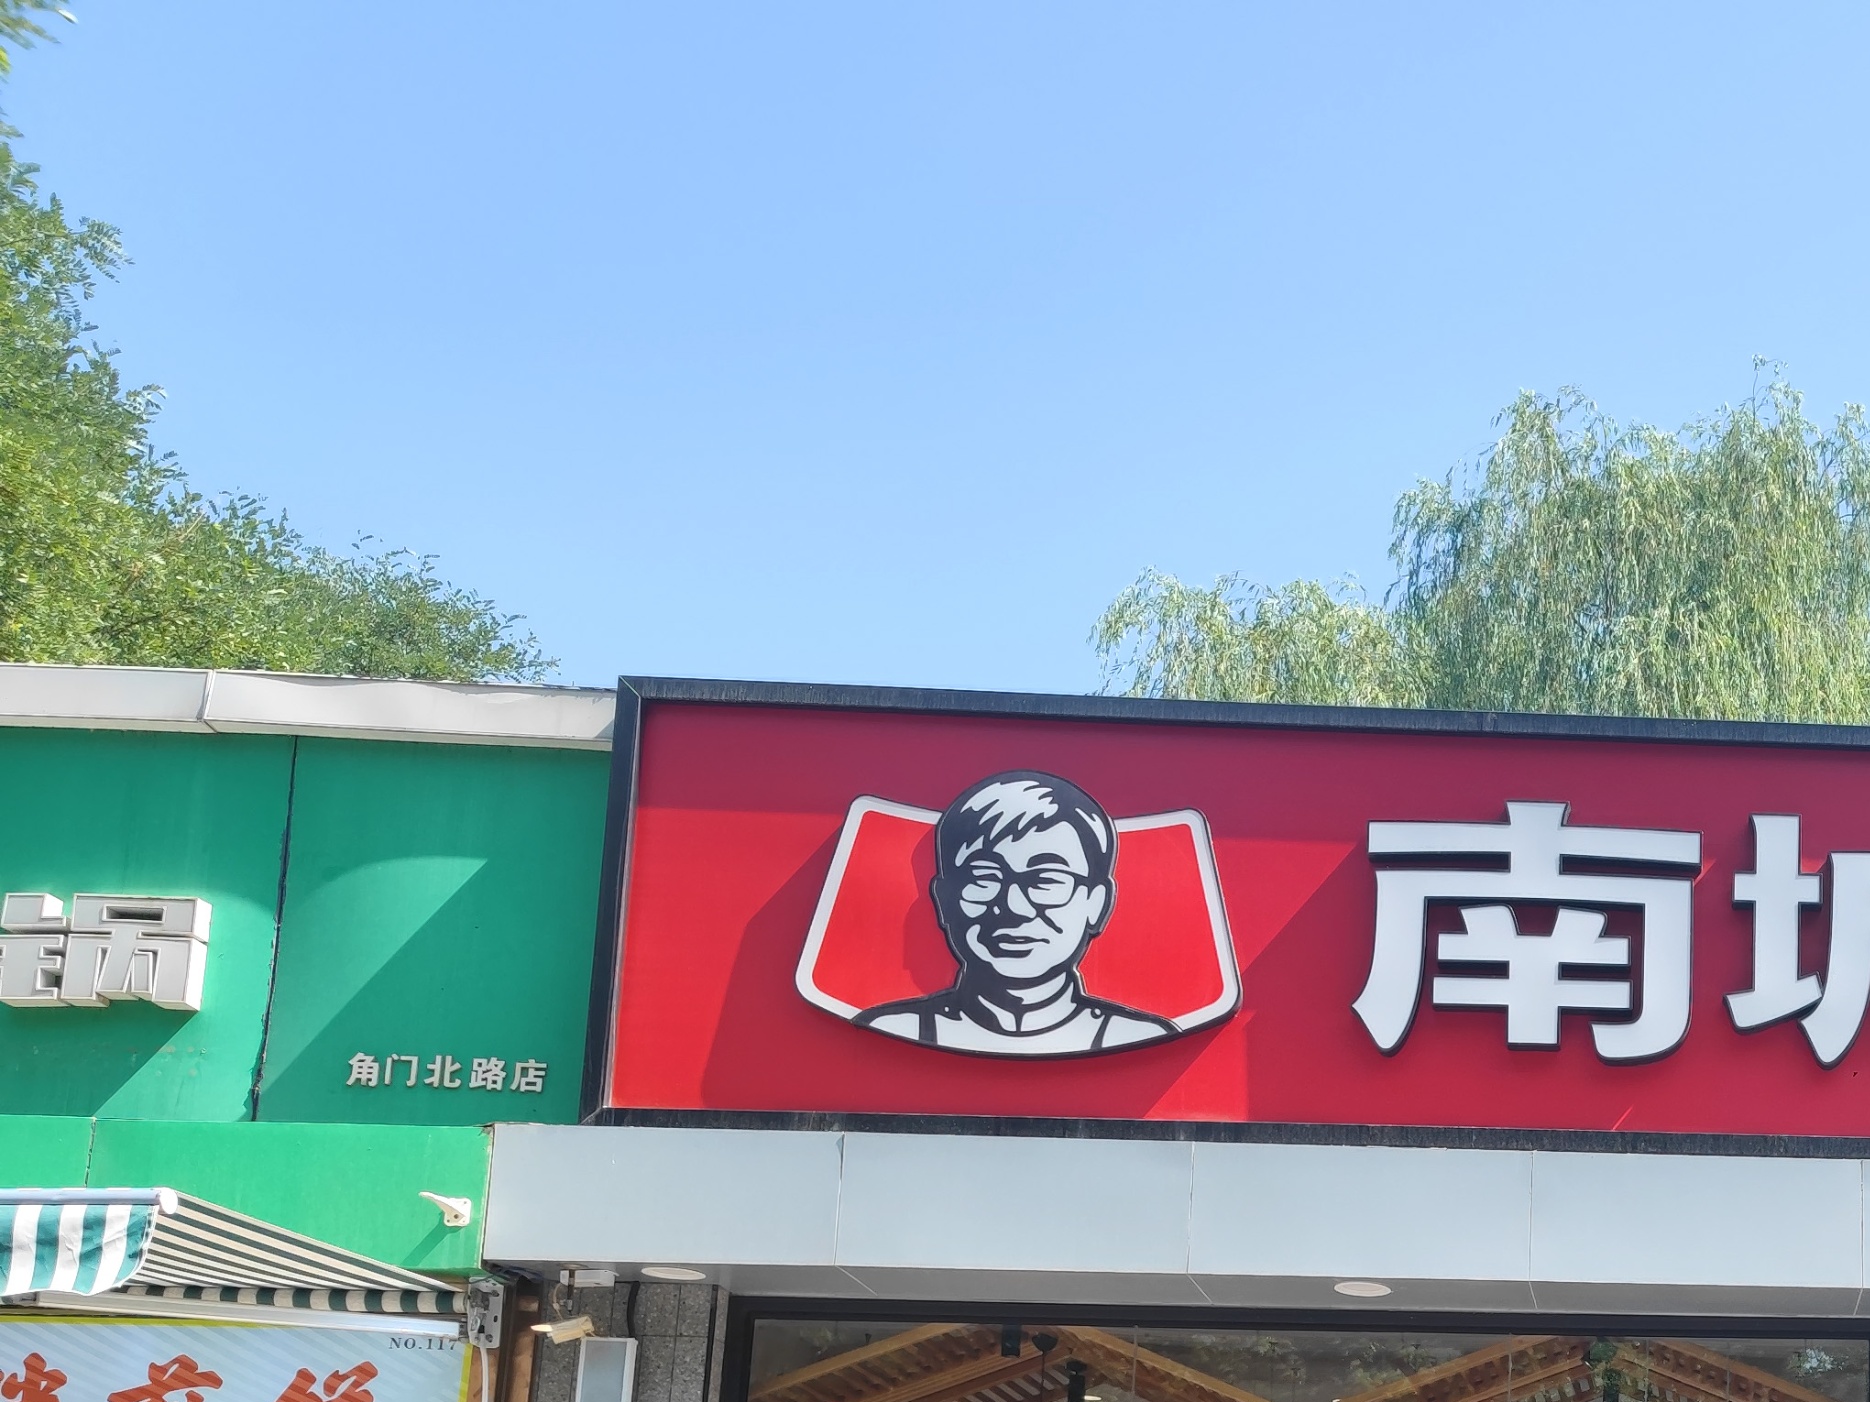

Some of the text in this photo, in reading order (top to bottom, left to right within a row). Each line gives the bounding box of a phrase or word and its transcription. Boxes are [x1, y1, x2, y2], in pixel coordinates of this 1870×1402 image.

[346, 1051, 548, 1093] 角门北路店
